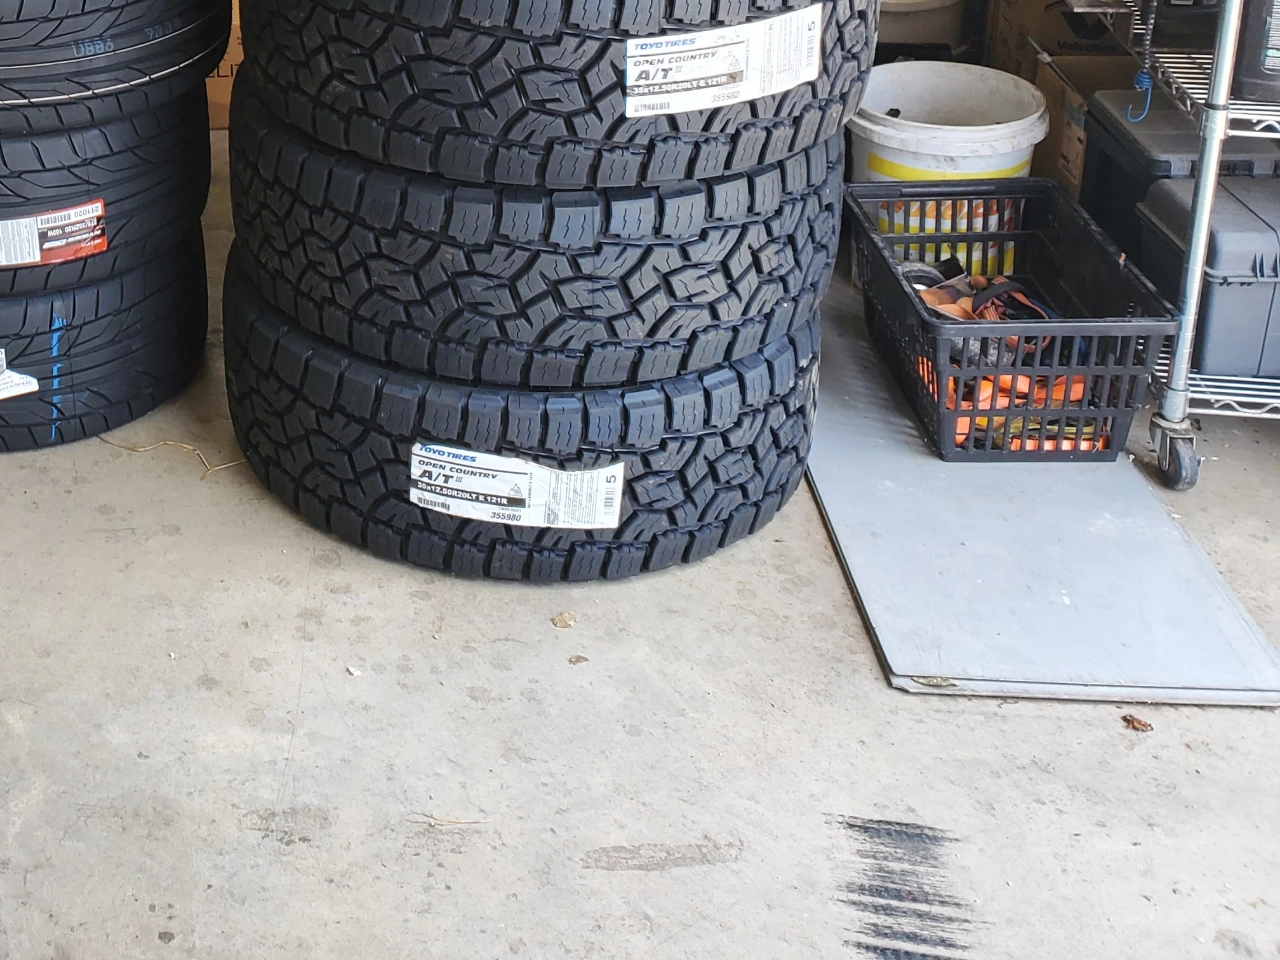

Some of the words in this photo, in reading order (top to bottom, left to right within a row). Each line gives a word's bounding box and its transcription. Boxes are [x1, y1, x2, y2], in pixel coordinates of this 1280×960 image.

[808, 21, 816, 31] 5
[634, 40, 662, 50] TOYO
[663, 38, 696, 49] TIRES
[633, 56, 665, 67] OPEN
[668, 51, 718, 64] COUNTRY
[634, 67, 673, 82] A/T
[631, 81, 699, 95] 35x12.50R20LT
[706, 76, 727, 87] 121R
[711, 91, 740, 103] 355980
[74, 206, 100, 217] 211020
[47, 229, 63, 237] 102W
[419, 443, 446, 457] TOYO
[446, 451, 477, 463] TIRES
[418, 459, 446, 471] OPEN
[449, 467, 498, 480] COUNTRY
[417, 469, 454, 484] A/T
[606, 475, 616, 484] 5
[416, 481, 478, 502] 35x12.50R20LT
[478, 494, 485, 502] E
[486, 495, 508, 505] 121R
[490, 511, 521, 522] 355980
